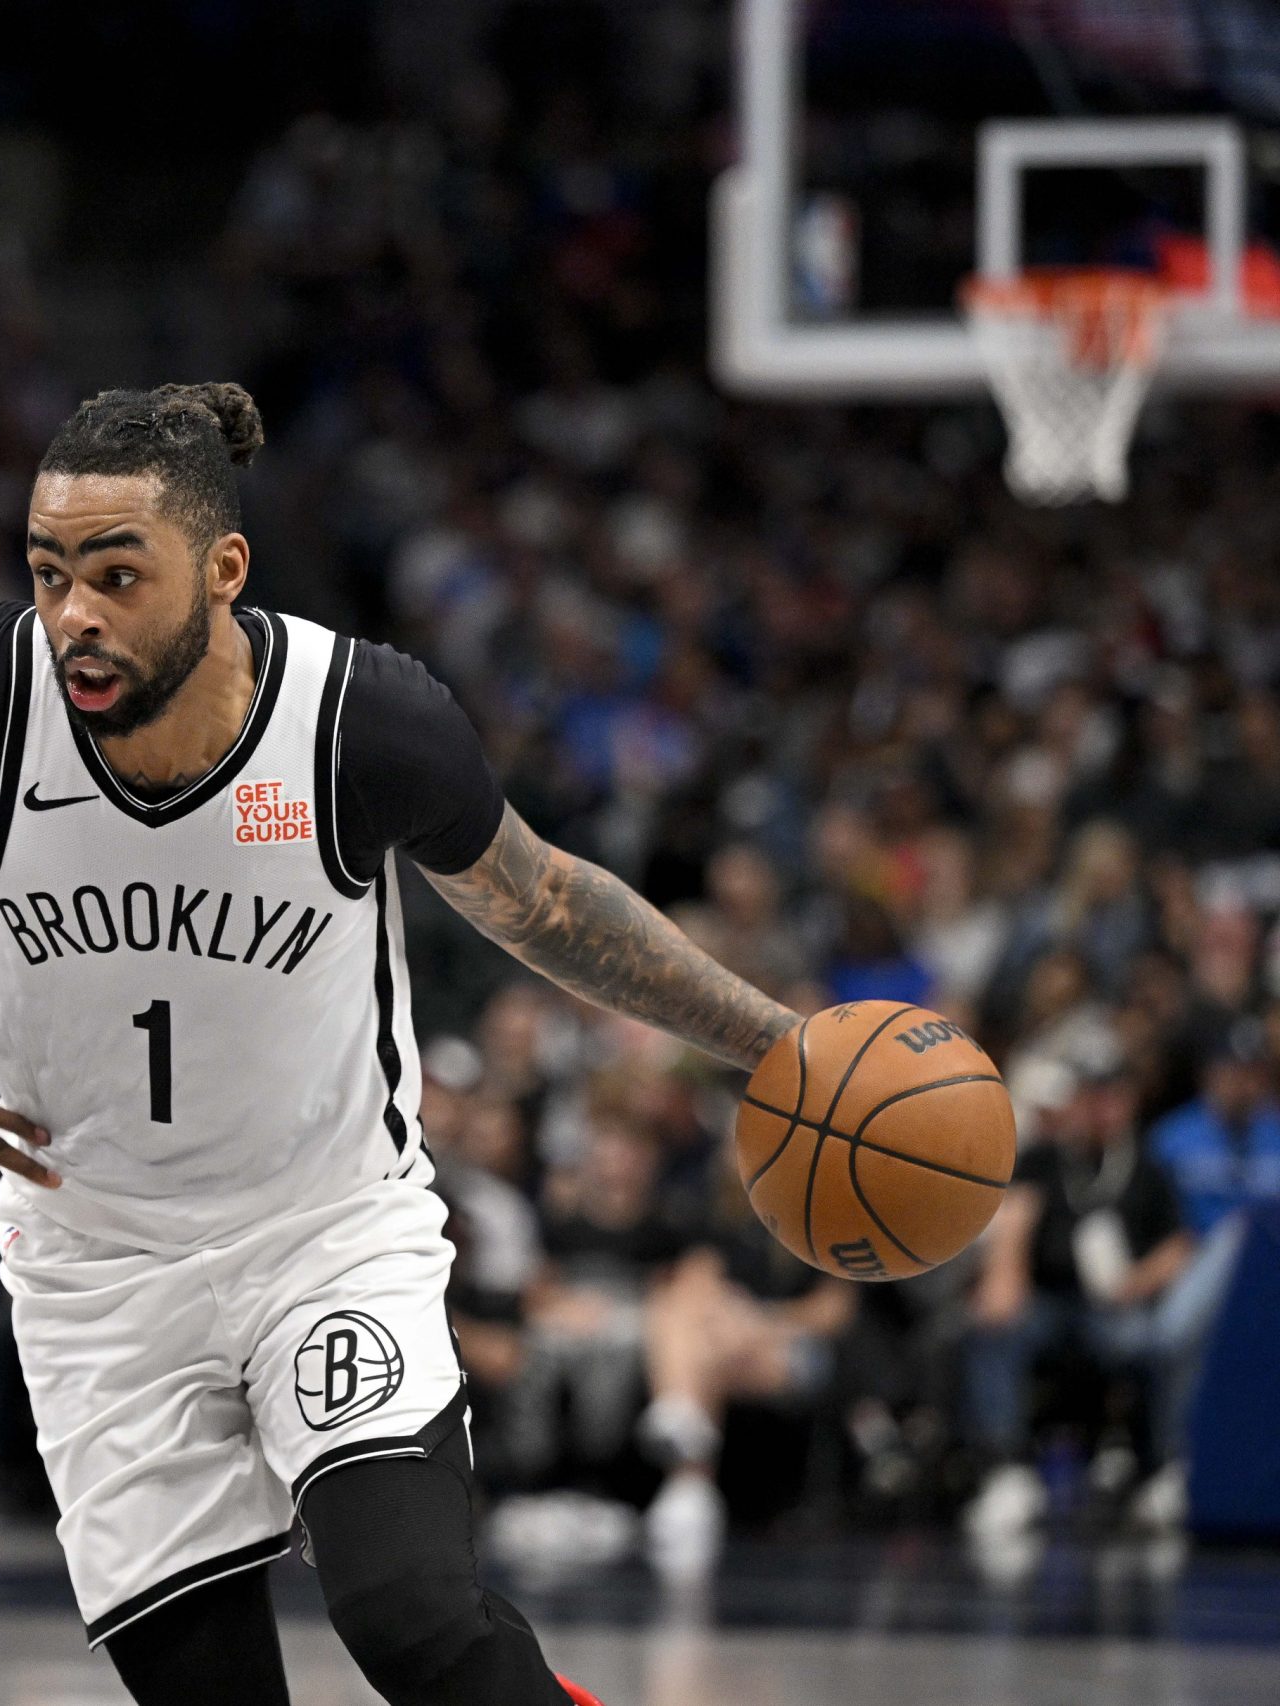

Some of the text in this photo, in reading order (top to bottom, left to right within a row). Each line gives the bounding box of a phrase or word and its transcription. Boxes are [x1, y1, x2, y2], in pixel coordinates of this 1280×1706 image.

[235, 782, 282, 802] GET
[236, 801, 308, 821] YOUR
[235, 822, 313, 842] GUIDE
[132, 999, 173, 1124] 1
[325, 1328, 358, 1413] B
